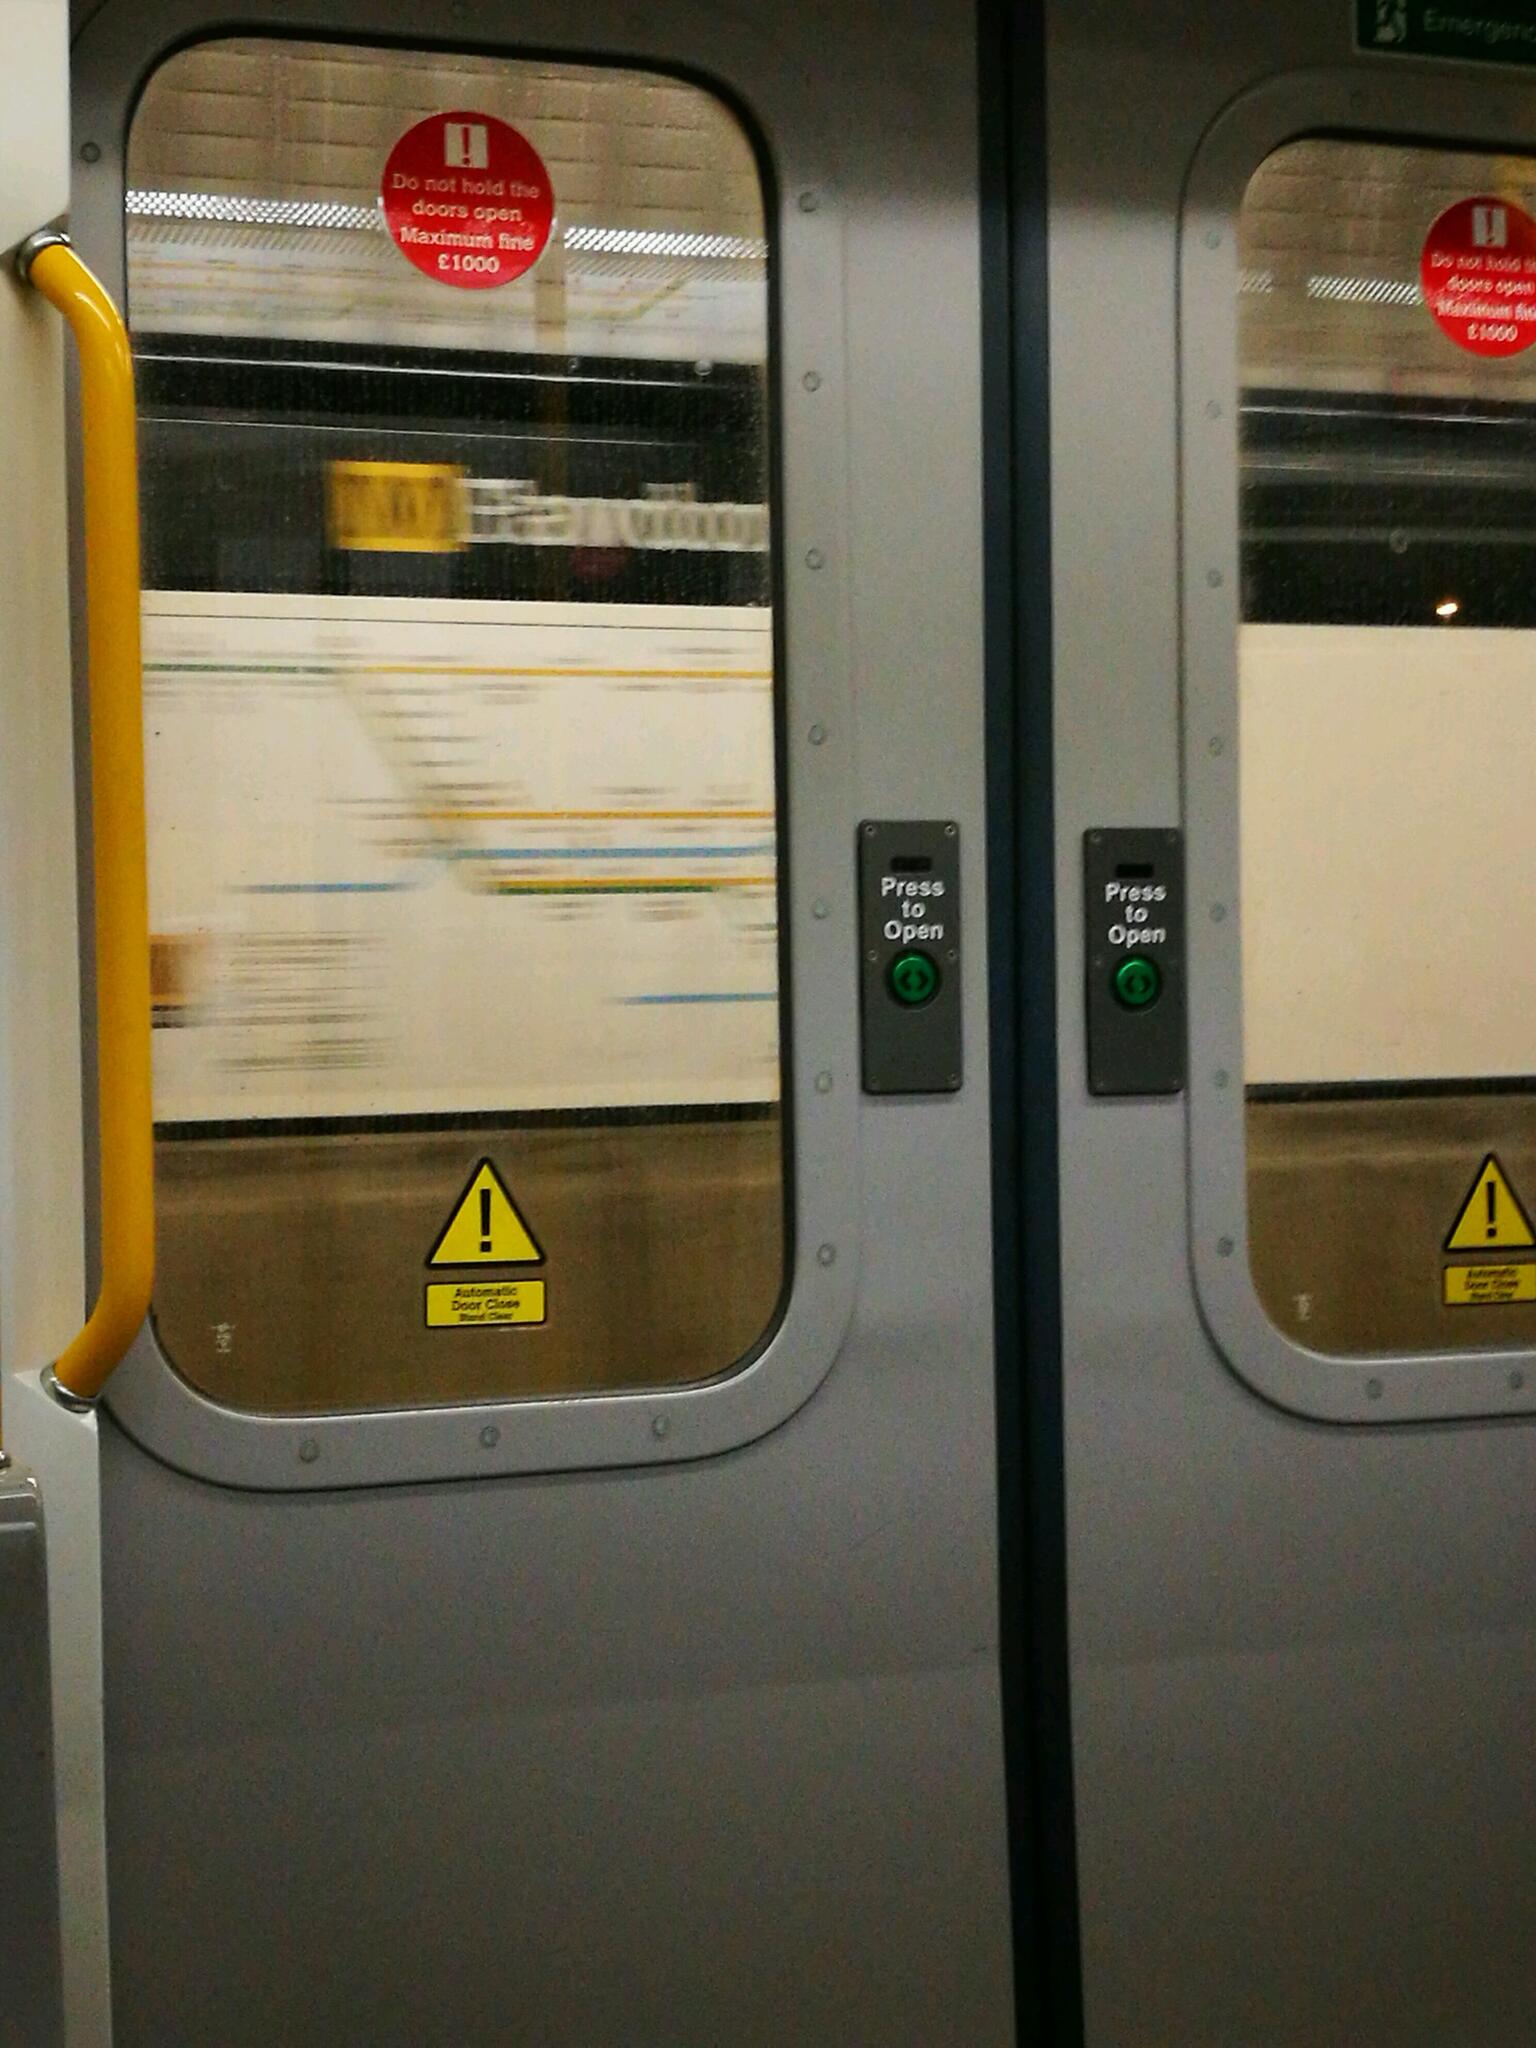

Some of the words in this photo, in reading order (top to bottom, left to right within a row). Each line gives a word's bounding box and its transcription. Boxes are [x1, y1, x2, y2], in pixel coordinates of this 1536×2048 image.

[391, 173, 419, 190] Do
[424, 177, 457, 193] not
[461, 178, 505, 196] hold
[509, 182, 541, 199] the
[411, 199, 468, 219] doors
[399, 226, 493, 249] Maximum
[497, 232, 536, 251] fine
[437, 253, 500, 273] £1000
[1430, 252, 1455, 268] Do
[1485, 255, 1522, 272] hold
[1446, 274, 1493, 294] doors
[1435, 299, 1514, 320] Maximum
[1466, 323, 1518, 342] £1000
[880, 877, 946, 897] Press
[1104, 882, 1168, 903] Press
[901, 900, 927, 919] to
[1124, 904, 1149, 923] to
[883, 920, 945, 945] Open
[1107, 924, 1167, 948] Open
[454, 1286, 518, 1298] Automatic
[451, 1300, 482, 1311] Door
